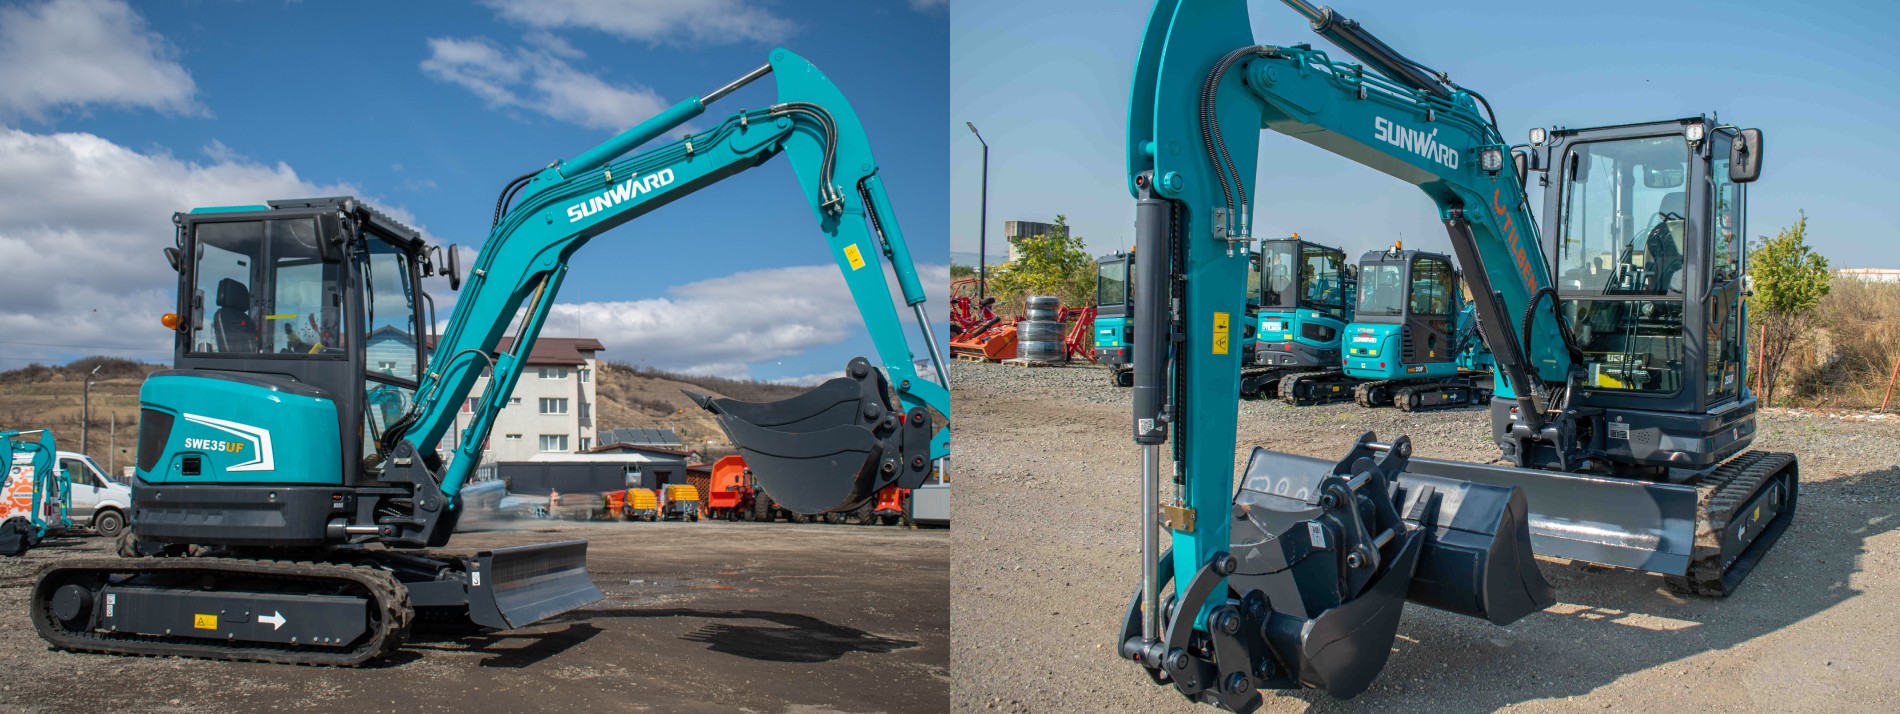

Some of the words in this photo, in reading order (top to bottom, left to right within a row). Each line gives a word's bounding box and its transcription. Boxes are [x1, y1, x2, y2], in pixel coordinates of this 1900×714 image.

[1374, 116, 1459, 170] SUNWARD
[567, 168, 675, 223] SUNWARD
[1493, 188, 1538, 296] UTILBEN
[184, 438, 245, 453] SWE35UF
